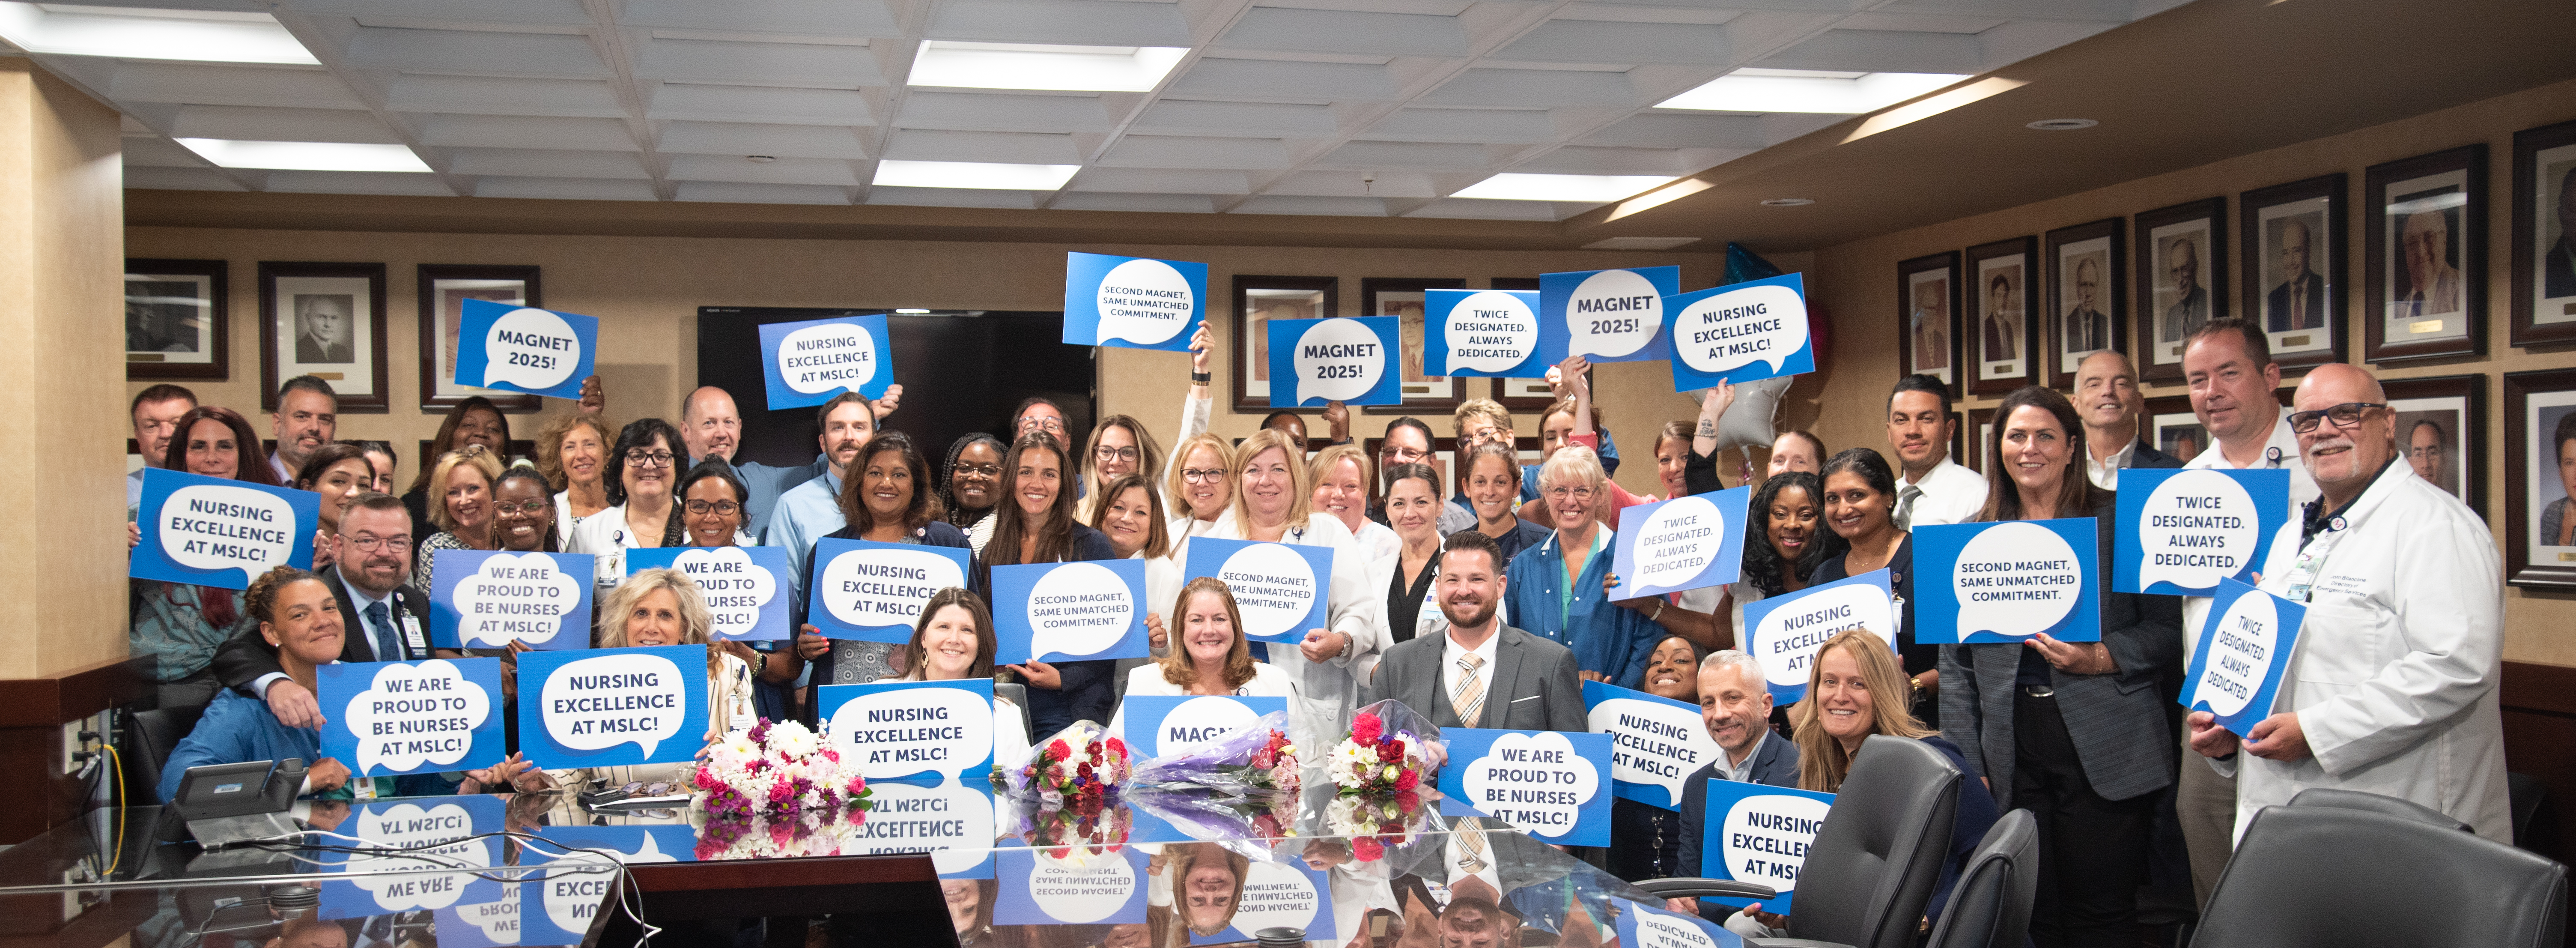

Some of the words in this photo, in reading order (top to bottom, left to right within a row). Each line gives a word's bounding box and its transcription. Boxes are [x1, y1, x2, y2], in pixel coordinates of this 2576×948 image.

[1105, 287, 1142, 295] SECOND
[1146, 290, 1186, 299] MAGNET,
[1131, 297, 1188, 310] UNMATCHED
[1578, 296, 1653, 313] MAGNET
[1111, 309, 1177, 320] COMMITMENT.
[1473, 310, 1508, 318] TWICE
[1703, 303, 1766, 324] NURSING
[1455, 323, 1527, 332] DESIGNATED.
[1591, 319, 1638, 334] 2025!
[1694, 318, 1782, 344] EXCELLENCE
[498, 330, 572, 351] MAGNET
[797, 337, 856, 350] NURSING
[1469, 336, 1512, 344] ALWAYS
[1305, 344, 1376, 358] MAGNET
[1458, 349, 1522, 358] DEDICATED.
[1709, 346, 1724, 359] AT
[1729, 339, 1771, 355] MSLC!
[509, 352, 555, 369] 2025!
[788, 352, 868, 368] EXCELLENCE
[801, 372, 816, 383] AT
[820, 368, 858, 380] MSLC!
[1318, 365, 1362, 379] 2025!
[2176, 496, 2221, 508] TWICE
[190, 499, 272, 522] NURSING
[1664, 515, 1697, 528] TWICE
[2153, 515, 2244, 528] DESIGNATED.
[172, 517, 285, 544] EXCELLENCE
[1644, 527, 1713, 546] DESIGNATED.
[2169, 535, 2224, 548] ALWAYS
[184, 540, 207, 553] AT
[212, 543, 266, 562] MSLC!
[1655, 544, 1697, 558] ALWAYS
[684, 563, 708, 573] WE
[713, 562, 742, 573] ARE
[1643, 557, 1705, 574] DEDICATED.
[1962, 562, 2011, 572] SECOND
[2016, 560, 2069, 571] MAGNET,
[2156, 553, 2237, 568] DEDICATED.
[491, 568, 514, 578] WE
[519, 568, 549, 580] ARE
[858, 564, 925, 580] NURSING
[1224, 572, 1263, 582] SECOND
[1266, 576, 1308, 587] MAGNET,
[694, 580, 728, 589] OUD
[733, 579, 754, 589] TO
[1961, 577, 1992, 587] SAME
[1997, 575, 2075, 586] UNMATCHED
[477, 583, 534, 598] PROUD
[538, 586, 559, 598] TO
[843, 581, 936, 599] EXCELLENCE
[1228, 585, 1246, 593] AME
[1249, 586, 1310, 598] UNMATCHED
[1972, 590, 2061, 601] COMMITMENT.
[703, 596, 756, 607] URSES
[1035, 595, 1076, 604] SECOND
[1080, 593, 1124, 602] MAGNET,
[1235, 598, 1297, 610] OMMITMENT.
[475, 602, 493, 613] BE
[498, 603, 559, 615] NURSES
[853, 600, 872, 612] AT
[876, 602, 921, 616] MSLC!
[1034, 608, 1061, 616] SAME
[1064, 605, 1128, 615] UNMATCHED
[712, 613, 749, 625] SLC!
[1044, 618, 1118, 628] COMMITMENT.
[1785, 605, 1851, 631] NURSING
[479, 620, 499, 631] AT
[504, 621, 551, 633] MSLC!
[2239, 616, 2263, 636] TWICE
[2220, 631, 2264, 661] DESIGNATED.
[1788, 655, 1804, 671] AT
[2221, 655, 2250, 677] ALWAYS
[385, 680, 413, 693] WE
[418, 678, 451, 691] ARE
[570, 673, 658, 690] NURSING
[2208, 671, 2247, 701] DEDICATED.
[373, 699, 436, 714] PROUD
[441, 697, 465, 710] TO
[555, 694, 674, 713] EXCELLENCE
[869, 707, 948, 722] NURSING
[373, 722, 394, 735] BE
[400, 718, 468, 733] NURSES
[571, 721, 594, 735] AT
[601, 717, 657, 733] MSLC!
[1619, 714, 1688, 741] NURSING
[855, 727, 962, 743] EXCELLENCE
[1170, 727, 1233, 742] MAG
[381, 742, 402, 755] AT
[408, 739, 461, 754] MSLC!
[1605, 730, 1697, 763] XCELLENCE
[869, 750, 890, 763] AT
[896, 748, 947, 762] MSLC!
[1502, 749, 1527, 762] WE
[1532, 750, 1563, 763] ARE
[1613, 752, 1631, 766] AT
[1633, 757, 1679, 779] MSLC!
[1488, 769, 1547, 783] PROUD
[1553, 772, 1576, 784] TO
[1487, 789, 1506, 801] BE
[1512, 790, 1576, 805] NURSES
[1493, 810, 1514, 822] AT
[1517, 810, 1568, 825] MSLC!
[1733, 833, 1810, 858] EXCELLE
[1745, 859, 1766, 875] AT
[1770, 862, 1799, 881] MSL
